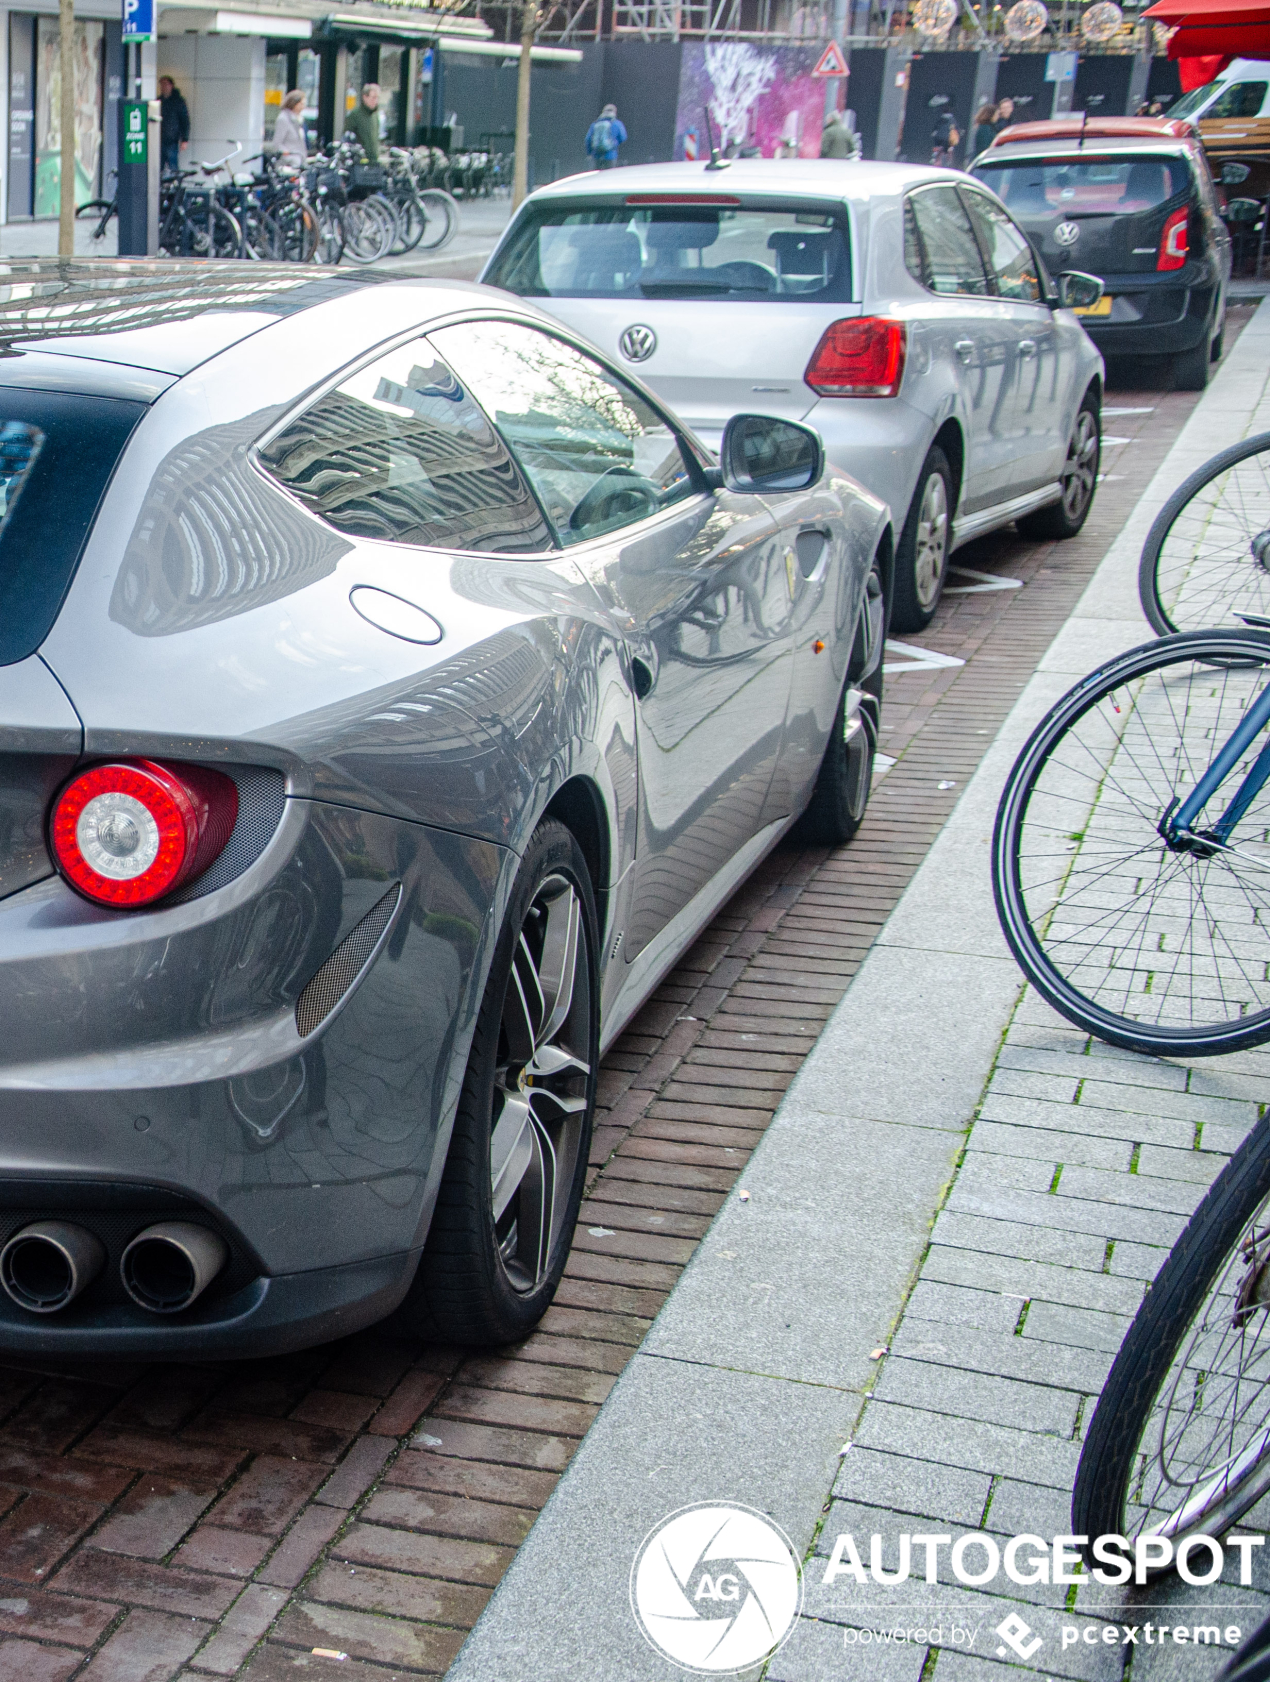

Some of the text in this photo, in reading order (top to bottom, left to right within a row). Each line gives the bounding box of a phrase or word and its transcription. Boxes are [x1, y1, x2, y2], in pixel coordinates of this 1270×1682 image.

[124, 0, 139, 20] P
[126, 132, 145, 140] ZONE
[129, 141, 142, 154] 11
